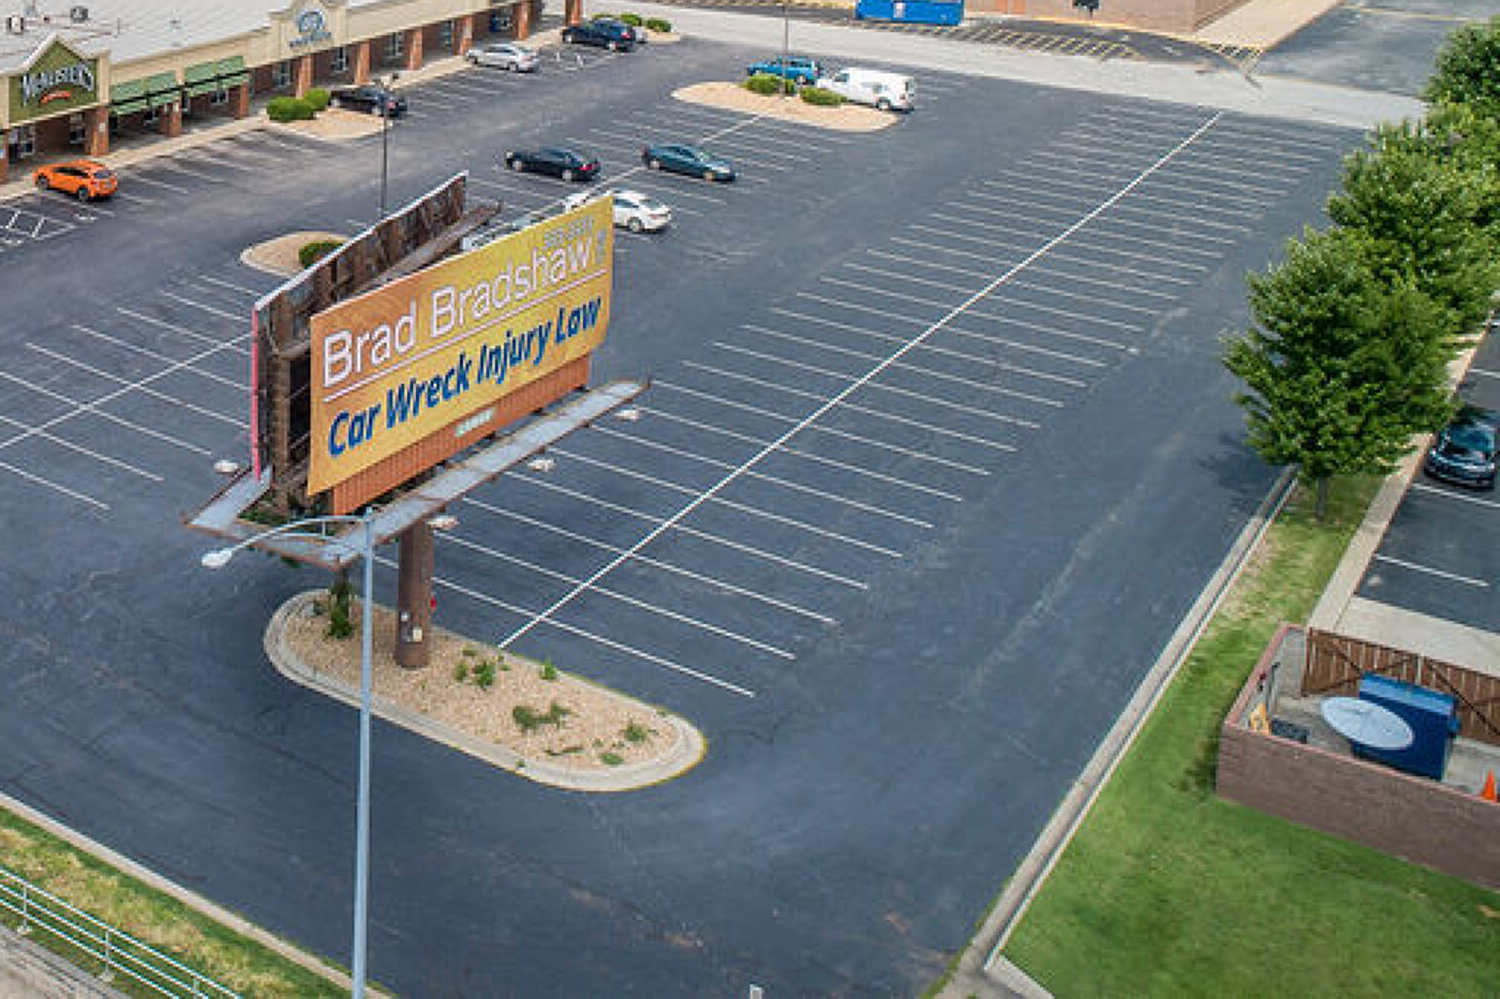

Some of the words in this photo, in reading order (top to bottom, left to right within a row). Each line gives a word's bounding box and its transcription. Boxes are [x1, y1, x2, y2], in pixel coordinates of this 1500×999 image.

[323, 299, 418, 389] Brad
[431, 238, 594, 338] Bradshaw
[328, 401, 381, 457] Car
[386, 353, 472, 430] Wreck
[476, 319, 551, 385] Injury
[555, 297, 602, 344] Law
